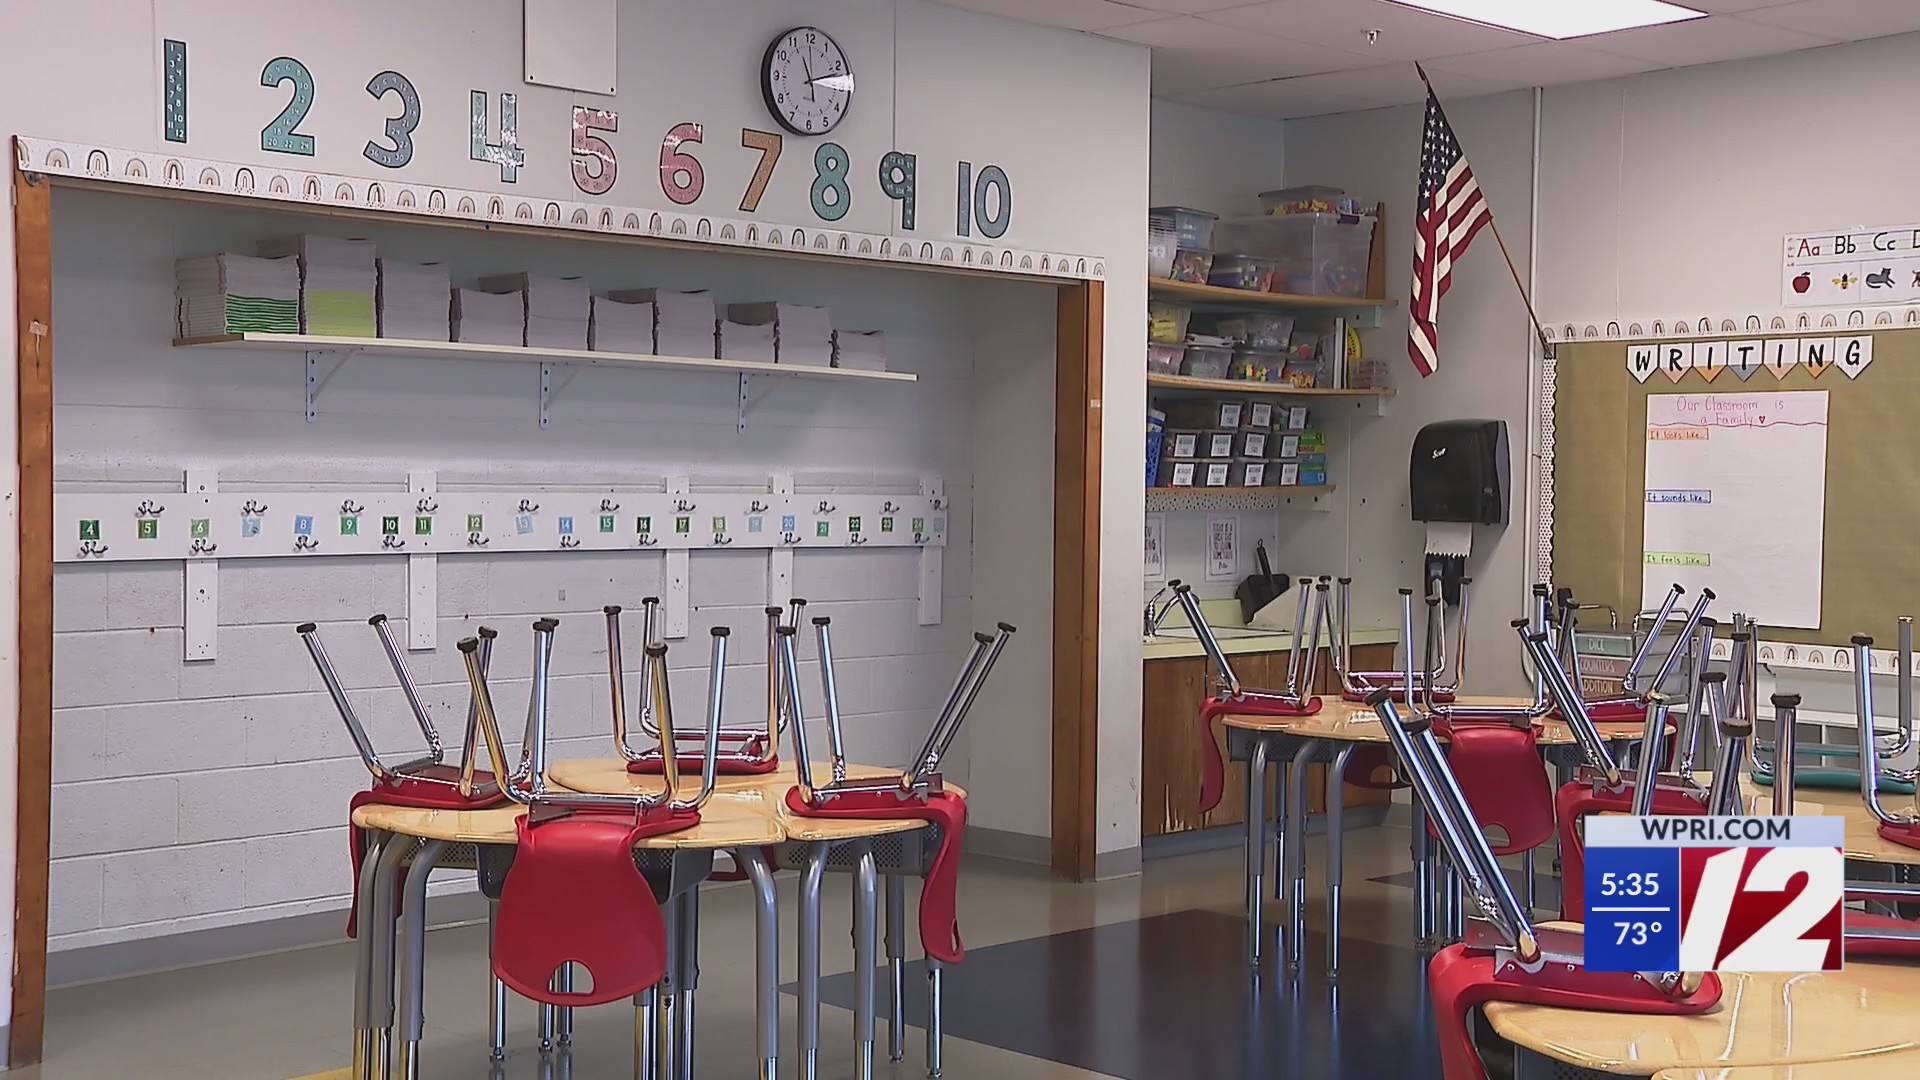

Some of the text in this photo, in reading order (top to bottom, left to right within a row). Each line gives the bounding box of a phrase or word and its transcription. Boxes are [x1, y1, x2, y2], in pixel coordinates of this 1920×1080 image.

[789, 36, 797, 48] 11
[805, 33, 815, 44] 12
[169, 43, 174, 52] 1
[824, 42, 828, 52] 1
[176, 53, 182, 61] 2
[777, 50, 787, 61] 10
[169, 60, 175, 68] 3
[836, 60, 841, 71] 2
[176, 68, 182, 76] 4
[773, 70, 779, 81] 9
[169, 75, 175, 83] 5
[176, 84, 182, 92] 6
[299, 81, 309, 90] 10
[169, 90, 174, 98] 7
[777, 93, 784, 104] 8
[167, 104, 173, 112] 9
[175, 99, 181, 107] 8
[834, 103, 839, 112] 4
[174, 114, 183, 122] 10
[789, 111, 795, 122] 7
[167, 121, 174, 129] 11
[806, 119, 811, 130] 6
[822, 117, 829, 127] 5
[175, 129, 184, 137] 12
[164, 39, 186, 143] 1
[261, 57, 314, 156] 2
[363, 71, 420, 168] 3
[471, 90, 524, 183] 4
[572, 105, 617, 195] 5
[661, 123, 704, 205] 6
[739, 128, 782, 212] 7
[811, 143, 850, 221] 8
[879, 151, 916, 230] 9
[957, 161, 1010, 238] 10
[1797, 238, 1820, 257] Aa
[1834, 235, 1856, 254] Bb
[1873, 231, 1896, 250] Cc
[1636, 339, 1860, 373] WRITING
[1676, 396, 1784, 411] Our Classroom is
[1701, 412, 1755, 428] a Family
[1664, 430, 1682, 440] looks
[1647, 492, 1656, 502] It
[1661, 493, 1686, 502] sounds
[86, 523, 94, 535] 4
[143, 522, 151, 534] 5
[196, 522, 204, 533] 6
[300, 518, 307, 529] 8
[346, 518, 353, 530] 9
[386, 518, 396, 530] 10
[418, 518, 427, 530] 11
[468, 517, 480, 528] 12
[560, 518, 570, 529] 14
[601, 516, 612, 528] 15
[640, 518, 649, 530] 16
[678, 519, 687, 530] 17
[783, 516, 793, 527] 20
[819, 523, 828, 532] 21
[850, 517, 860, 528] 22
[882, 518, 892, 528] 23
[1660, 554, 1681, 564] feels
[1579, 658, 1615, 673] COUNTERS
[1583, 679, 1613, 694] DDITION
